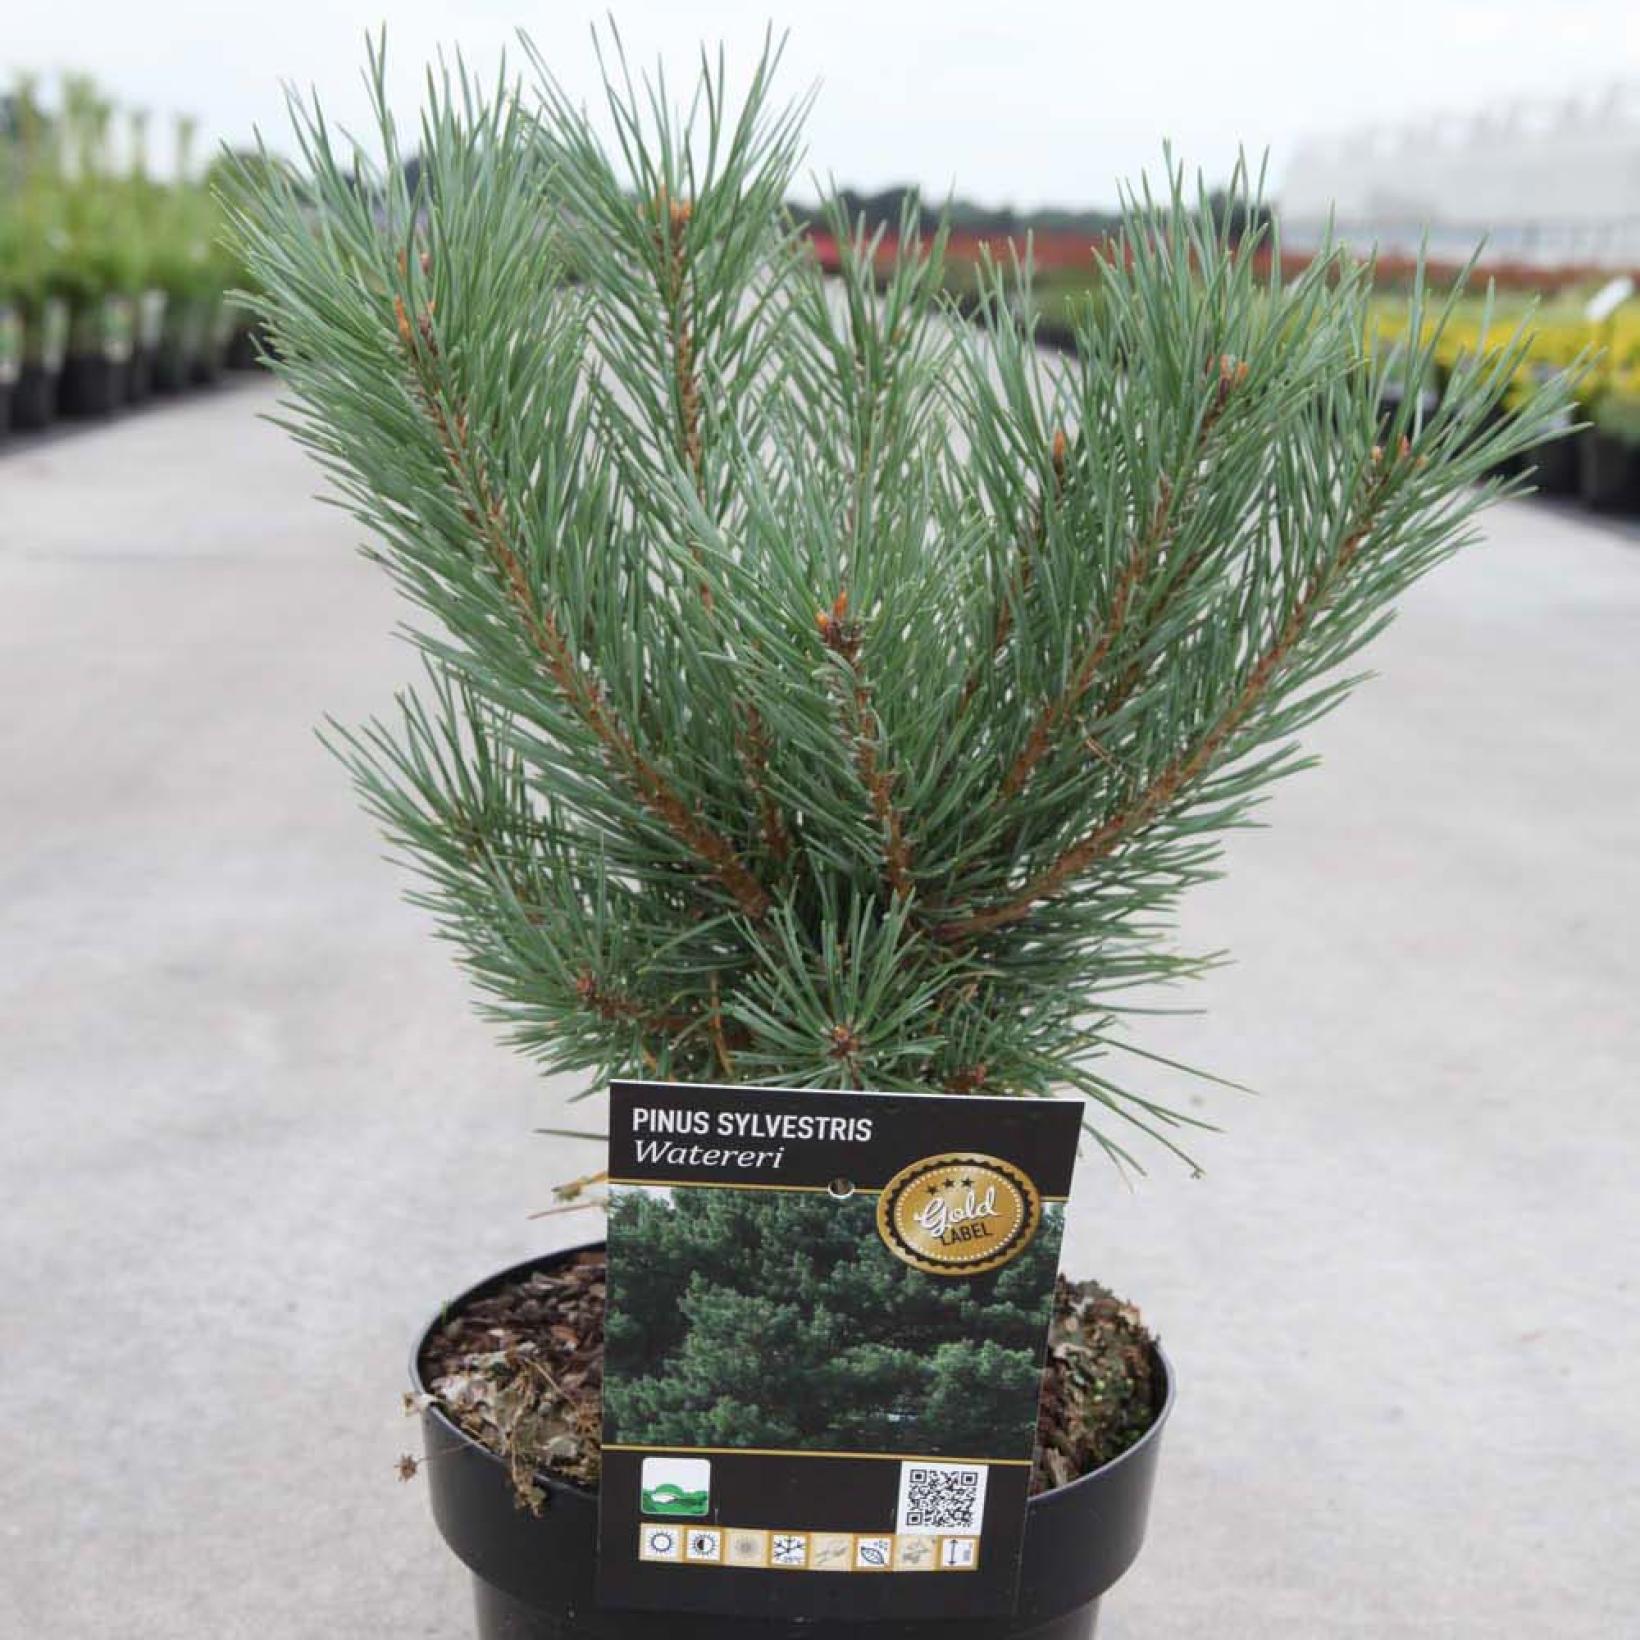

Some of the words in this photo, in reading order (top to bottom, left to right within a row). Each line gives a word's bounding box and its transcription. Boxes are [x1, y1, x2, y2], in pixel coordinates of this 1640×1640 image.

[632, 1107, 709, 1134] PINUS
[717, 1112, 872, 1142] SYLVESTRIS
[634, 1139, 784, 1168] Watereri
[913, 1187, 999, 1237] Gold
[941, 1222, 994, 1246] LABEL
